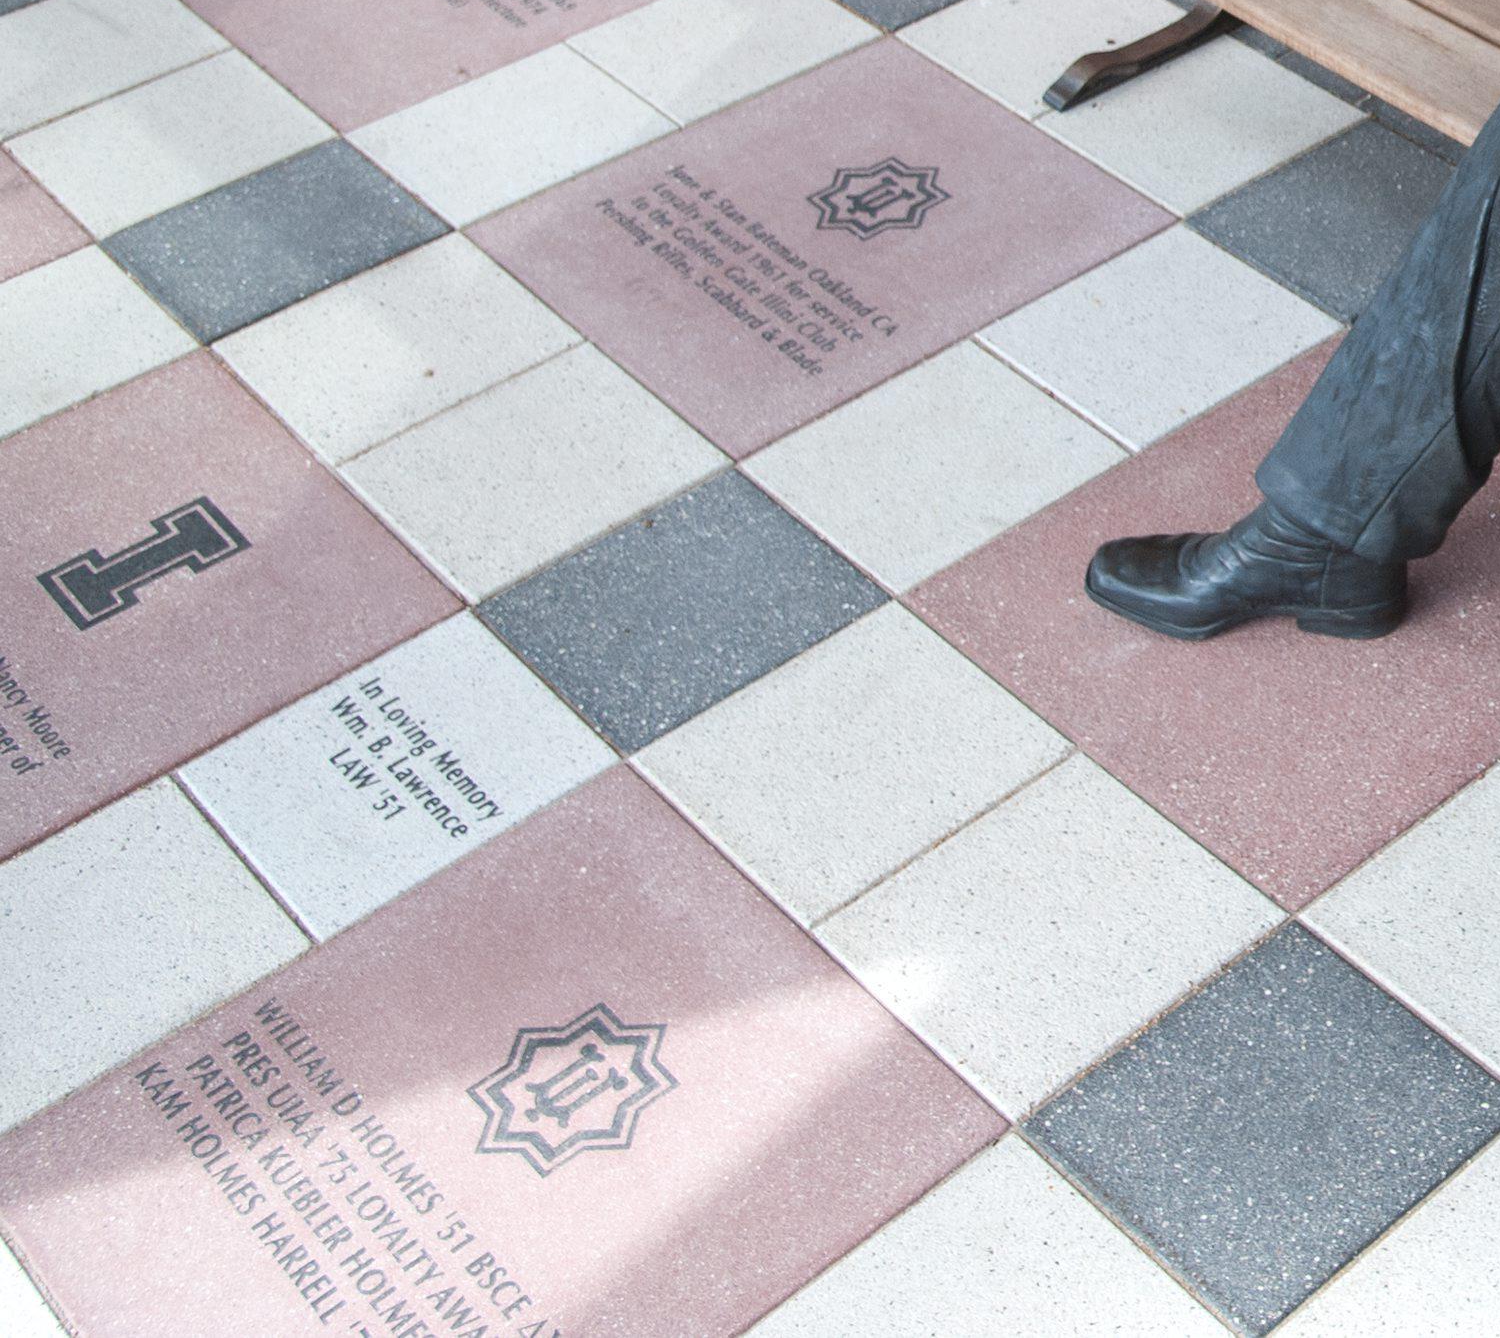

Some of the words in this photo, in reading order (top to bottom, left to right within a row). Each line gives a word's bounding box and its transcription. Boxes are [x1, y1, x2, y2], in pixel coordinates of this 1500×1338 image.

[594, 197, 655, 247] Pershing
[694, 275, 769, 330] Scabbard
[760, 328, 781, 343] &
[776, 339, 824, 376] Blade
[630, 195, 650, 211] to
[647, 208, 674, 229] the
[672, 227, 725, 268] Golden
[723, 265, 761, 296] Gate
[758, 292, 799, 325] Illini
[796, 321, 838, 353] Club
[651, 182, 701, 221] Loyalty
[703, 219, 754, 255] Award
[747, 252, 788, 282] 1961
[784, 280, 811, 300] for
[808, 301, 864, 343] service
[698, 188, 717, 202] &
[713, 198, 748, 226] Stan
[807, 268, 879, 318] Oakland
[870, 315, 899, 338] CA
[11, 755, 44, 776] of
[22, 705, 71, 760] Moore
[330, 748, 380, 789] LAW
[373, 789, 406, 820] '51
[332, 696, 368, 739] Wm.
[368, 736, 392, 759] B.
[387, 757, 468, 837] Lawrence
[360, 678, 383, 700] In
[378, 697, 437, 756] Loving
[433, 750, 505, 822] Memory
[135, 1062, 191, 1120] KAM
[176, 1115, 266, 1215] HOLMES
[251, 1212, 344, 1325] HARRELL
[186, 1055, 269, 1150] PATRICA
[259, 1146, 353, 1252] KUEBLER
[340, 1247, 435, 1338] HOLME
[222, 1031, 280, 1086] PRES
[267, 1083, 324, 1148] UIAA
[346, 1182, 444, 1286] LOYALTY
[254, 997, 343, 1097] WILLIAM
[331, 1092, 361, 1116] D
[351, 1115, 444, 1215] HOLMES
[465, 1252, 531, 1320] BSCE
